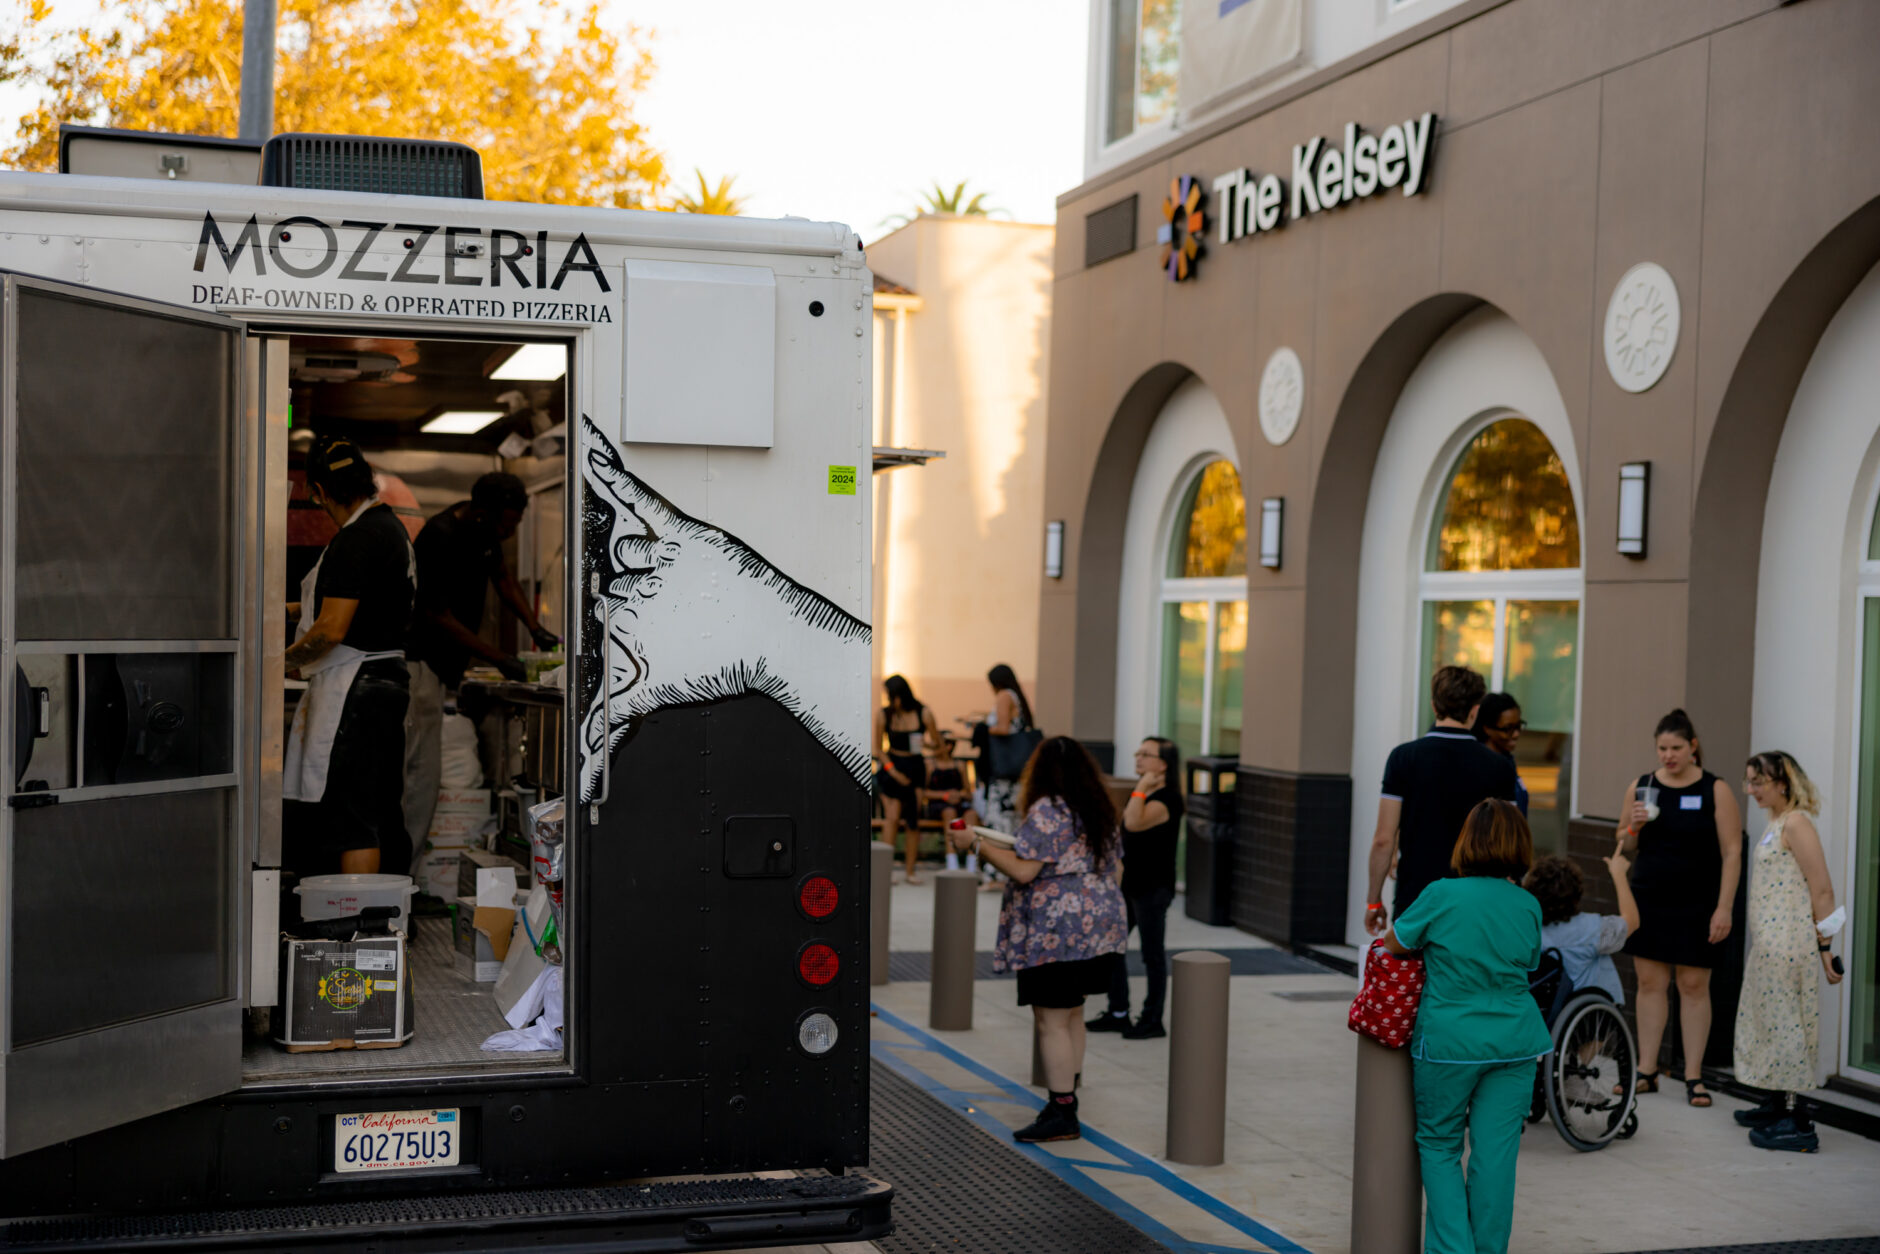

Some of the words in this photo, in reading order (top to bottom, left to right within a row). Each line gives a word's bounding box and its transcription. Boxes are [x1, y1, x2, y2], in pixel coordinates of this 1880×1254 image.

[1213, 167, 1284, 244] The
[1291, 112, 1436, 219] Kelsey
[193, 210, 612, 293] MOZZERIA
[192, 285, 354, 311] DEAF-OWNED
[361, 294, 379, 312] &
[385, 295, 505, 318] OPERATED
[512, 301, 613, 323] PIZZERIA
[831, 474, 854, 484] 2024
[341, 1117, 358, 1126] OCT
[362, 1113, 438, 1131] California
[344, 1130, 451, 1163] 60275U3
[366, 1160, 429, 1168] dmv.ca.gov
